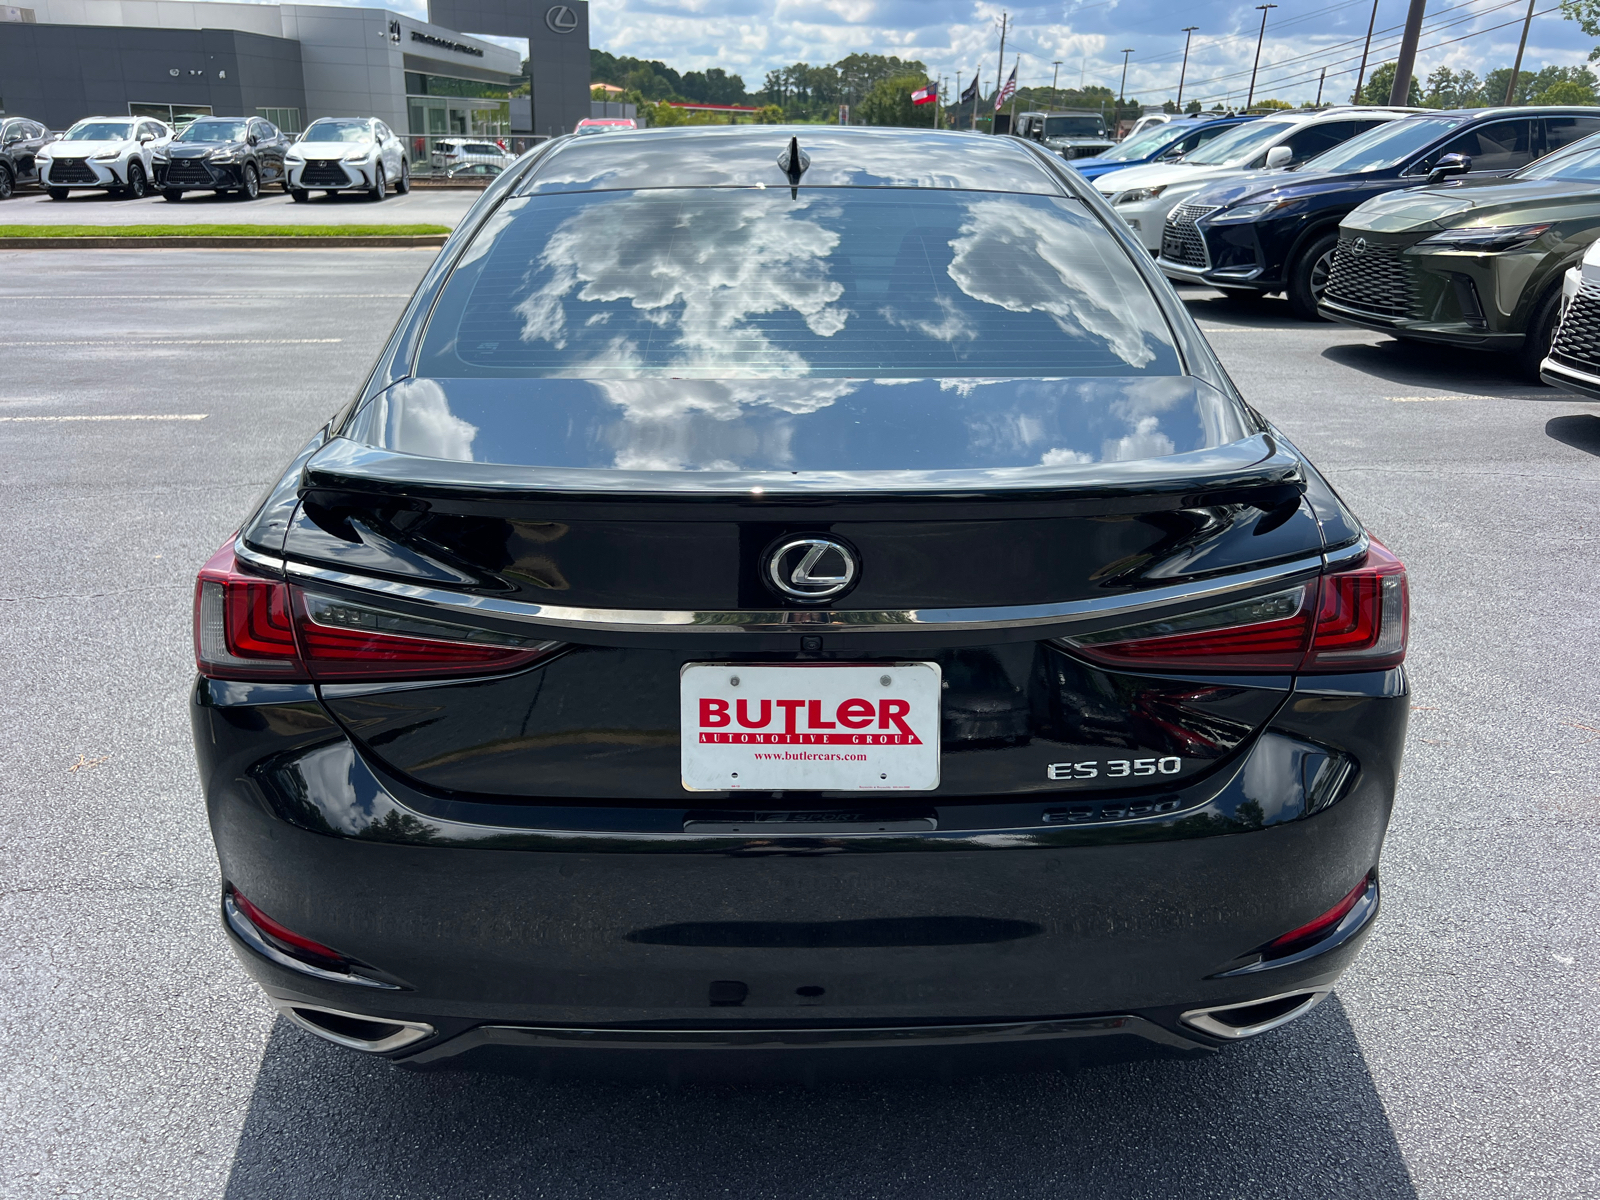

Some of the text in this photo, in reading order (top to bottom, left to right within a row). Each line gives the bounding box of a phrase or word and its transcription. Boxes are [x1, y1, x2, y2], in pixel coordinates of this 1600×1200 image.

[700, 733, 915, 744] AUTOMOTIVE GROUP
[754, 751, 867, 761] www.butlercars.com
[1047, 756, 1181, 780] ES 350
